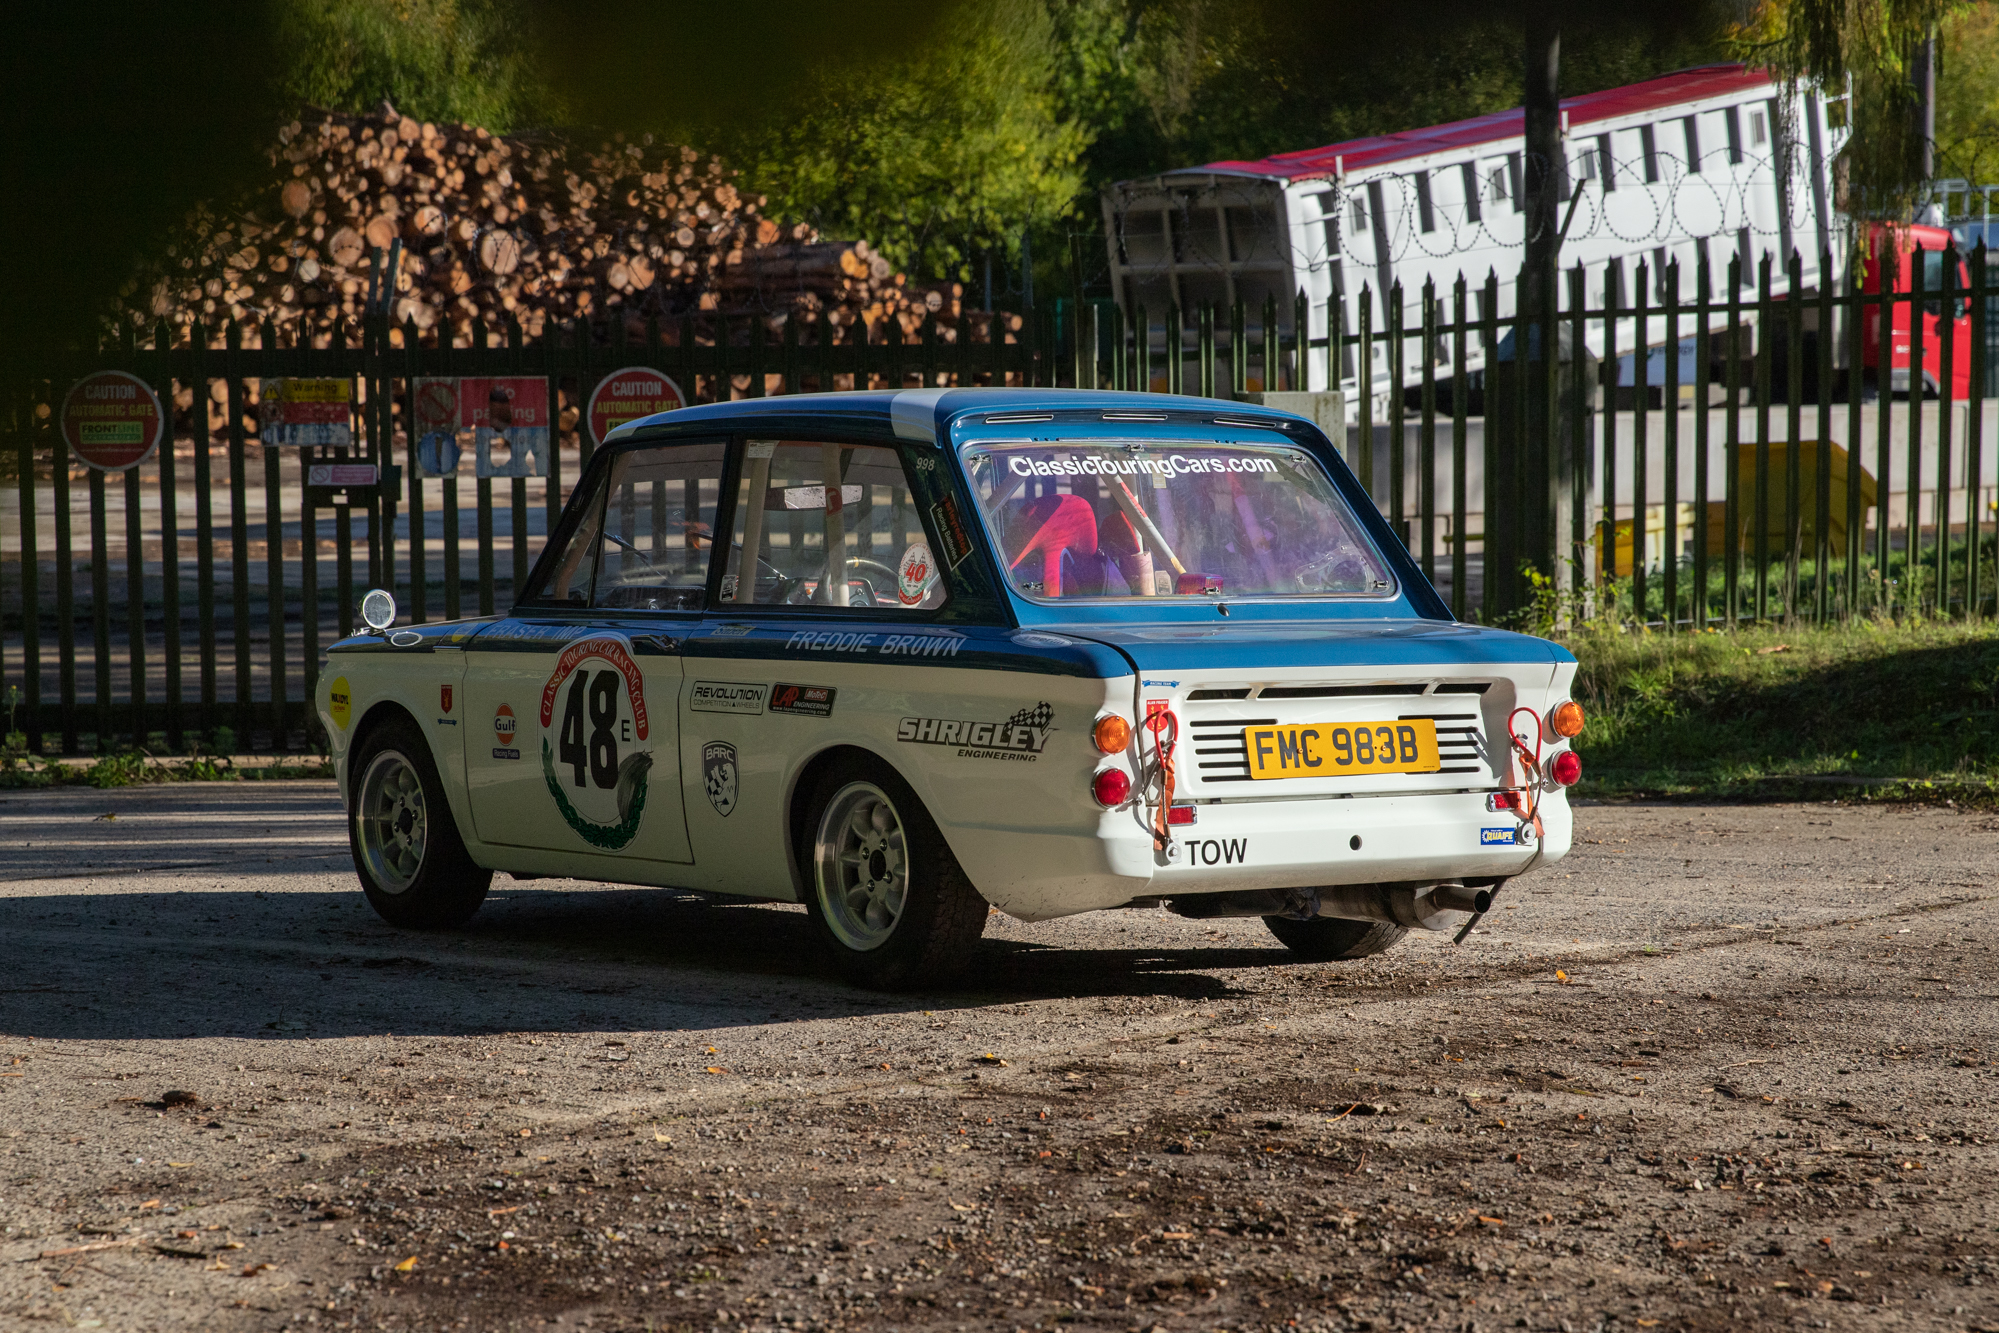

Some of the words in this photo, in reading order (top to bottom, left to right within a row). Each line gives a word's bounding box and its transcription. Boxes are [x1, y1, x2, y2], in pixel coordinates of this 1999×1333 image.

[85, 385, 136, 400] CAUTION
[293, 383, 337, 394] Warning
[612, 381, 662, 397] CAUTION
[69, 404, 126, 417] AUTOMATIC
[128, 404, 153, 416] GATE
[596, 400, 652, 414] AUTOMATIC
[654, 400, 679, 413] GATE
[916, 457, 935, 471] 998
[1009, 454, 1279, 479] ClassicTouringCars.com
[936, 507, 948, 531] Racing
[944, 530, 958, 561] Batteries
[905, 563, 927, 582] 40
[484, 624, 553, 639] FRASER
[551, 625, 588, 640] IMP
[785, 631, 878, 653] FREDDIE
[879, 634, 967, 657] BROWN
[543, 667, 567, 717] CLASSIC
[564, 640, 600, 668] TOURING
[598, 641, 617, 657] CAR
[613, 649, 640, 691] RACING
[631, 691, 647, 730] CLUB
[694, 687, 763, 701] REVOLUTION
[772, 684, 800, 707] LAP
[693, 699, 732, 708] COMPETITION
[736, 702, 760, 710] WHEELS
[793, 701, 831, 711] ENGINEERING
[495, 718, 516, 731] Gulf
[560, 669, 620, 790] 48
[622, 719, 631, 742] E
[897, 716, 1059, 754] SHRIGLEY
[494, 749, 508, 759] Racing
[508, 750, 519, 758] Fuels
[706, 746, 734, 762] BARC
[957, 749, 1037, 762] ENGINEERING
[1254, 729, 1322, 770] FMC
[1332, 725, 1419, 766] 983B
[1486, 831, 1514, 842] QUAIFE
[1184, 838, 1248, 866] TOW
